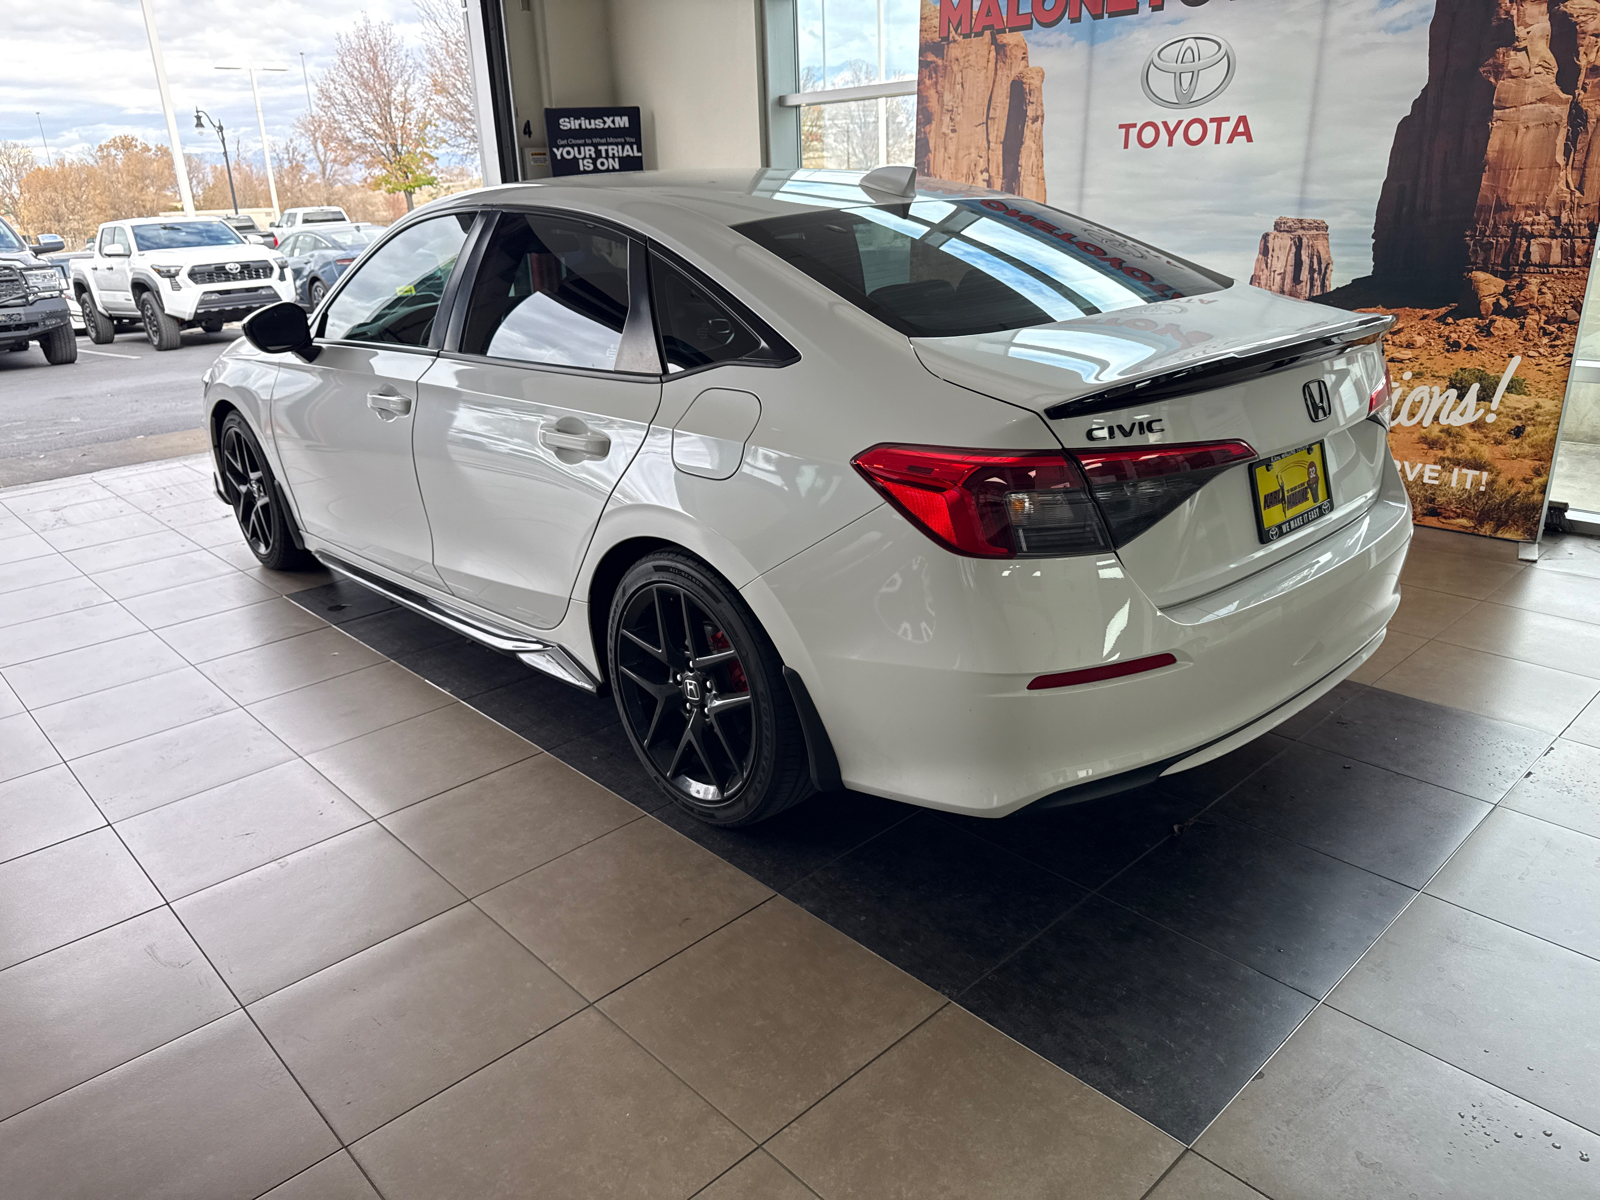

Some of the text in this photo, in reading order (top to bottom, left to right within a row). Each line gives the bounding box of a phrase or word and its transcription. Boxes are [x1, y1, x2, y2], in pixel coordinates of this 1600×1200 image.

[523, 119, 532, 138] 4
[559, 116, 629, 130] SiriusXM
[1118, 114, 1254, 150] TOYOTA
[552, 146, 596, 160] YOUR
[598, 144, 642, 158] TRIAL
[579, 157, 620, 171] IS ON
[1086, 418, 1165, 442] CIVIC
[1450, 468, 1489, 492] IT!
[1282, 524, 1290, 534] WE
[1290, 517, 1303, 528] MAKE
[1309, 509, 1319, 521] EASY
